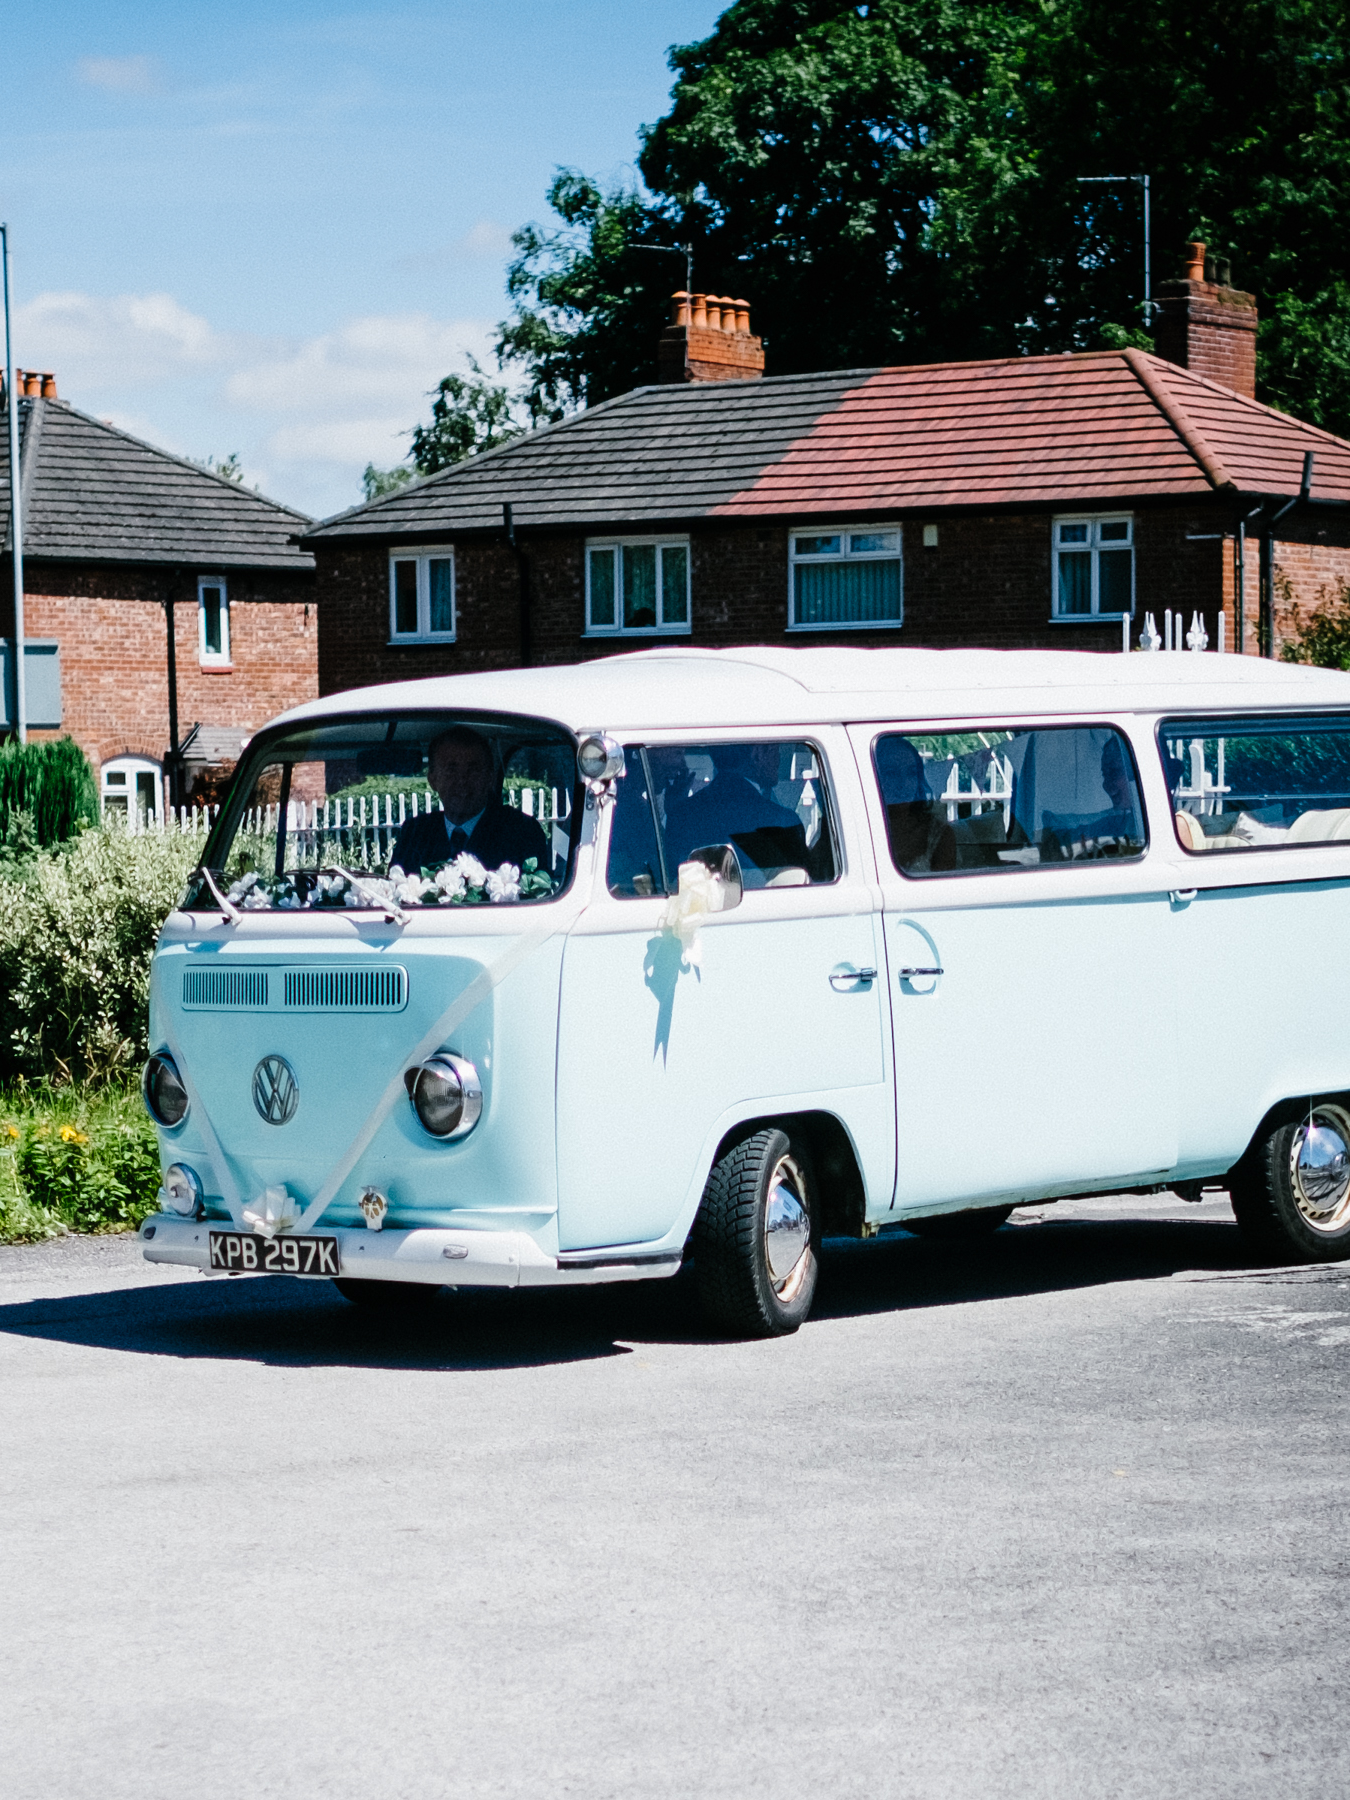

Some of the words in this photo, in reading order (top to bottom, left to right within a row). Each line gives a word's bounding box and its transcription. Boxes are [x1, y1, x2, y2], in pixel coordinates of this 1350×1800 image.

[252, 1055, 299, 1125] VW
[210, 1235, 258, 1269] KPB
[264, 1238, 337, 1273] 297K
